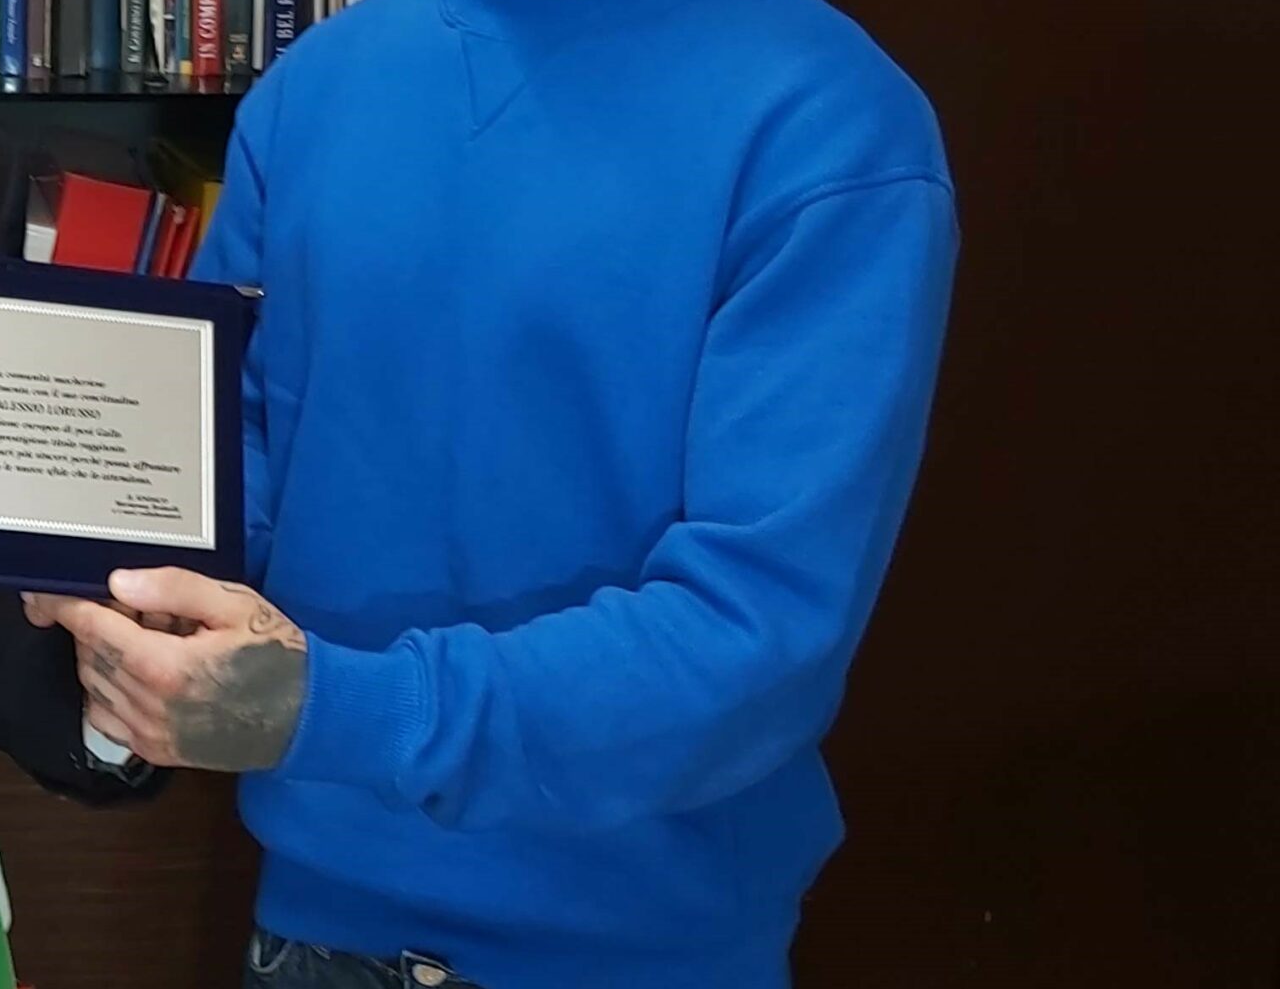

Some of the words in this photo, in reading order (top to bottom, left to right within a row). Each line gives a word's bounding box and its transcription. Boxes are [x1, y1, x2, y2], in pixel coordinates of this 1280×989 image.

[276, 10, 294, 39] BEL
[198, 42, 217, 59] IN
[46, 404, 101, 420] LORUSSO
